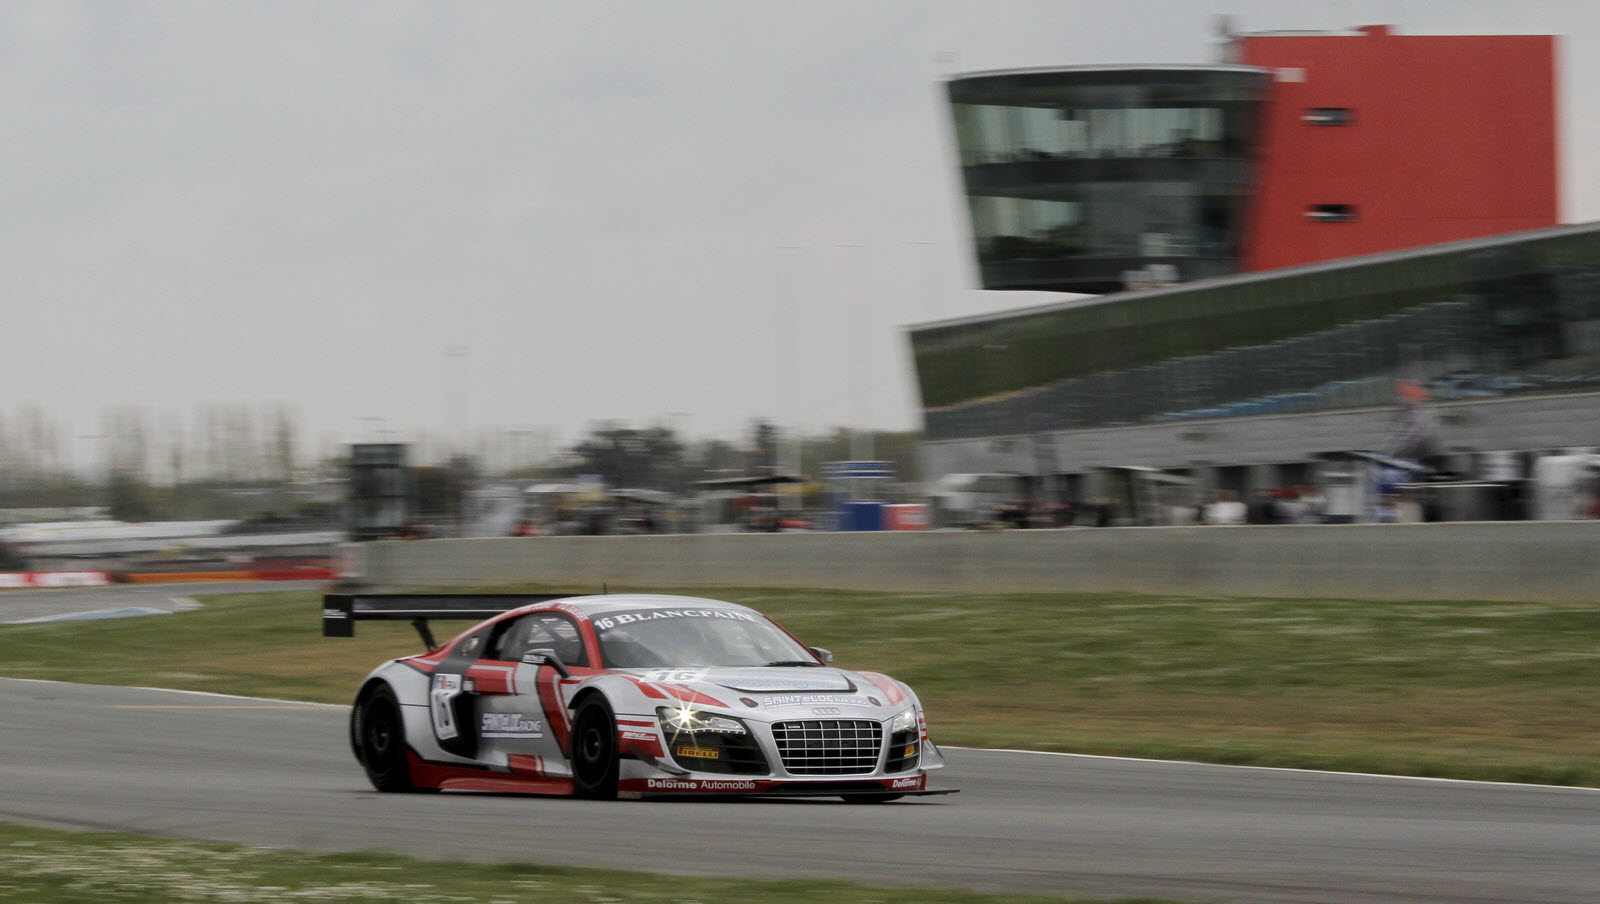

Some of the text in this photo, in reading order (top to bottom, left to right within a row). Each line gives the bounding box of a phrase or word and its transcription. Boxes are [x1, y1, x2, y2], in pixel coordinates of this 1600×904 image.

[594, 610, 756, 630] 16 BLANCPAIN
[656, 671, 696, 682] 16
[678, 746, 719, 759] PIRELLI
[700, 780, 756, 790] Automobile
